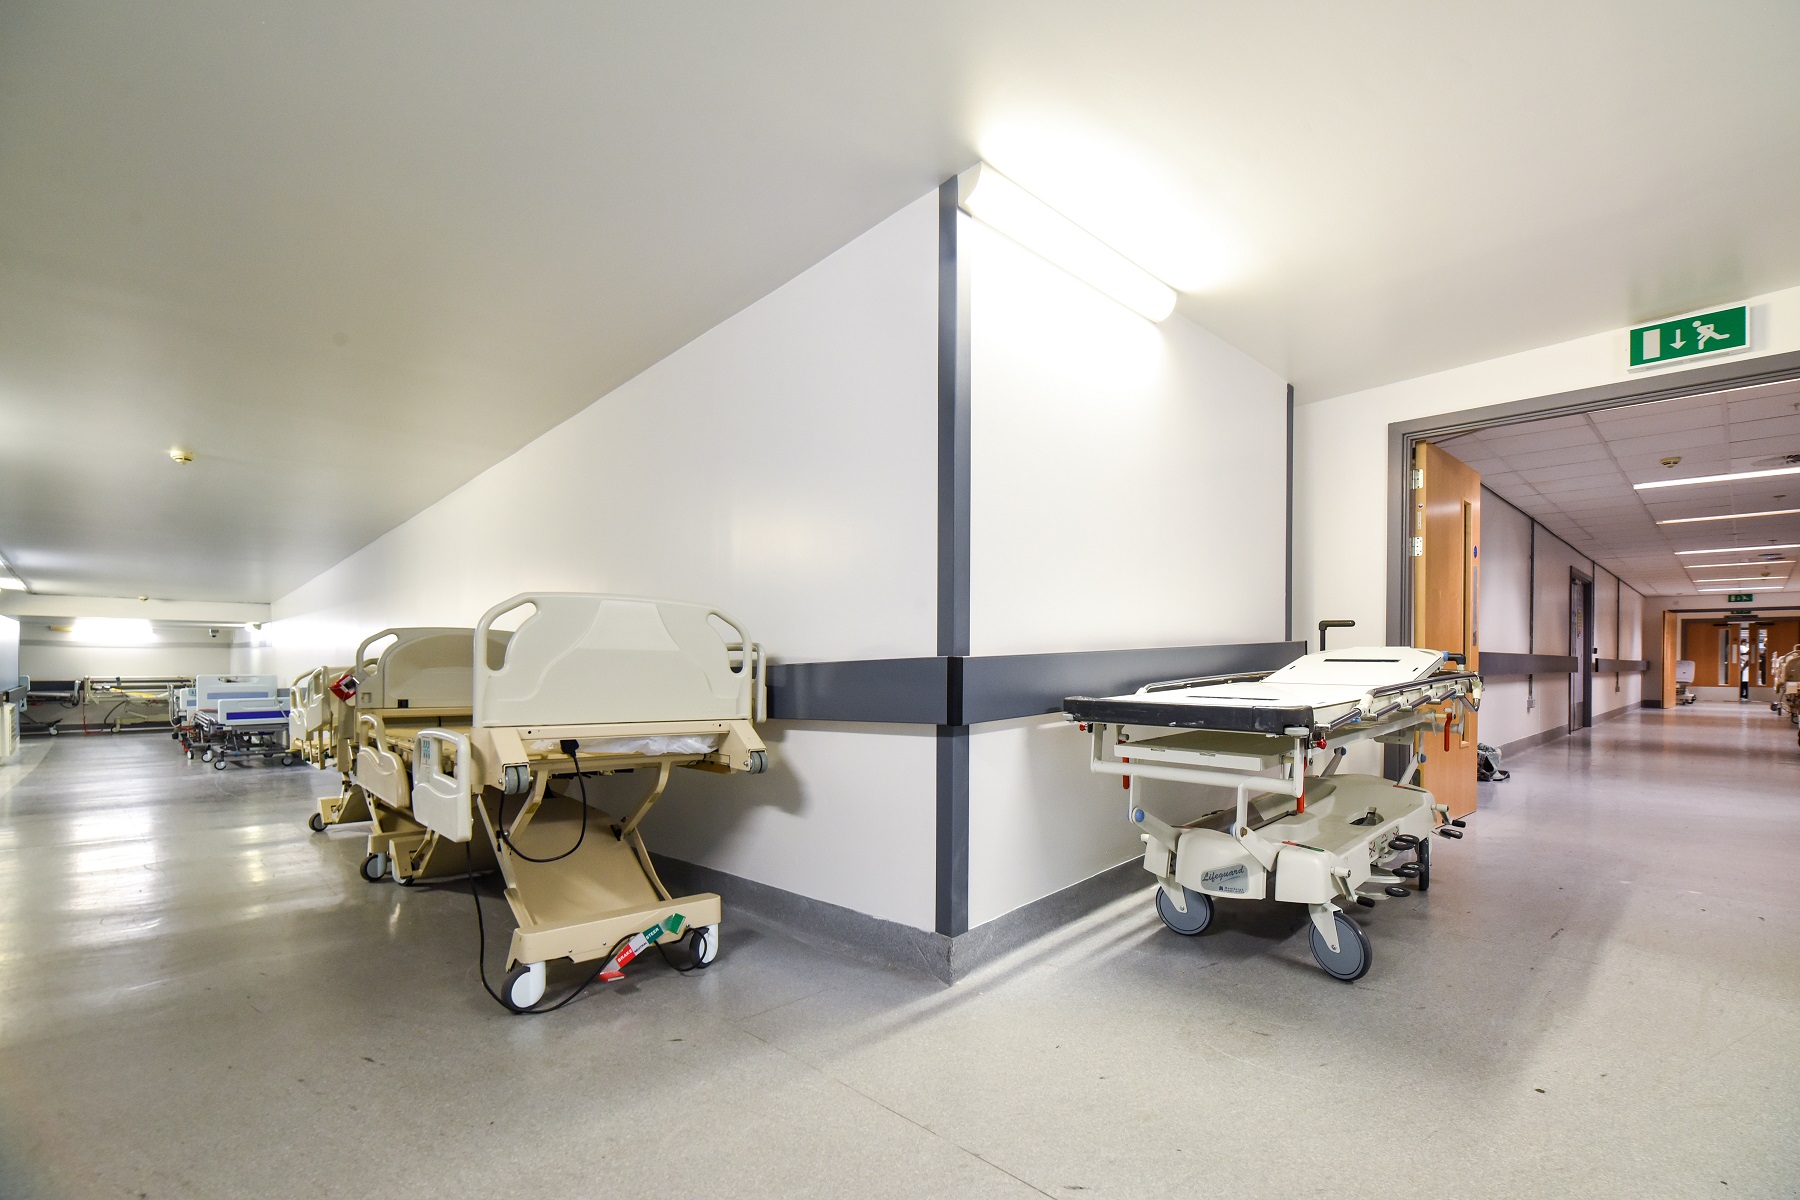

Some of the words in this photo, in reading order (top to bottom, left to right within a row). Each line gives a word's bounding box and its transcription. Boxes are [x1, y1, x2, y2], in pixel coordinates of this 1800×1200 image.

[1202, 865, 1244, 882] Lifeguard
[645, 927, 660, 940] STEER
[617, 948, 632, 963] BRAKE
